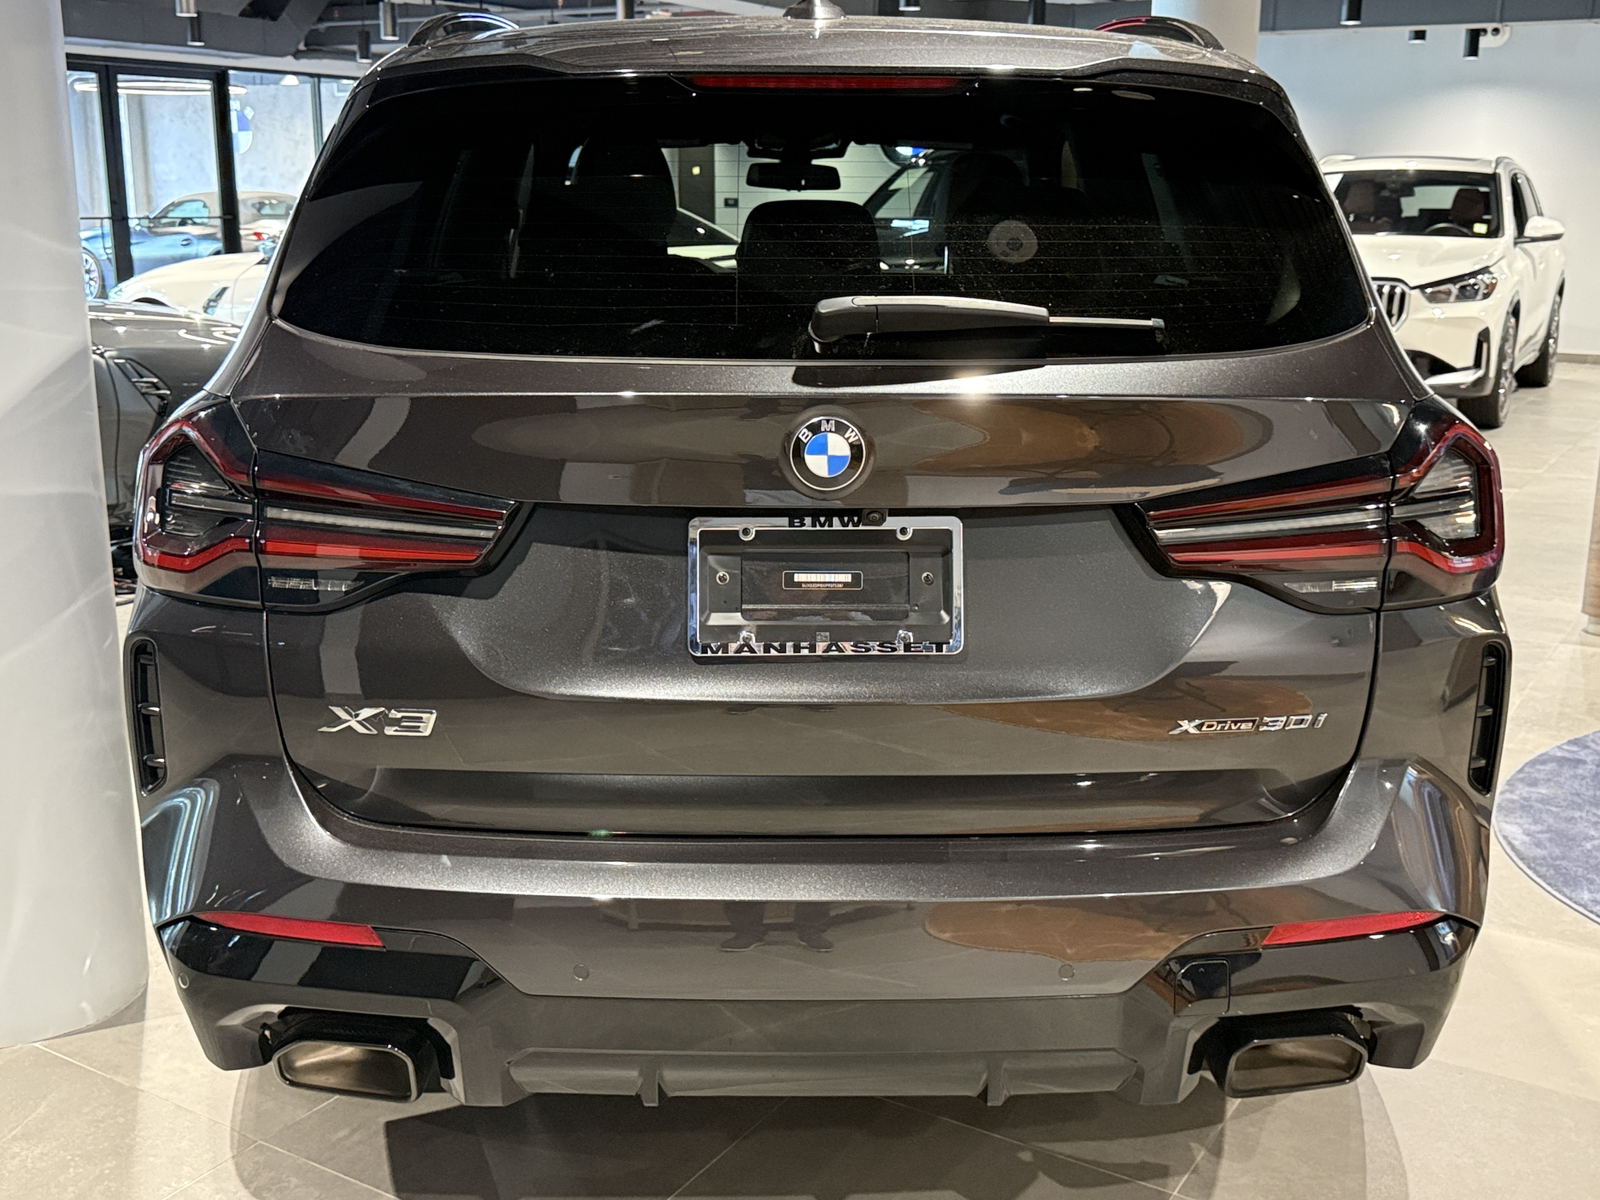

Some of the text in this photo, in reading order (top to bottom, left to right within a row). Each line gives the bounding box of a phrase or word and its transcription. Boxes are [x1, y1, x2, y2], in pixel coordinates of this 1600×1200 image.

[798, 419, 859, 444] BMW
[788, 516, 864, 528] BMW
[700, 642, 949, 654] MANHASSET
[317, 705, 437, 737] X3
